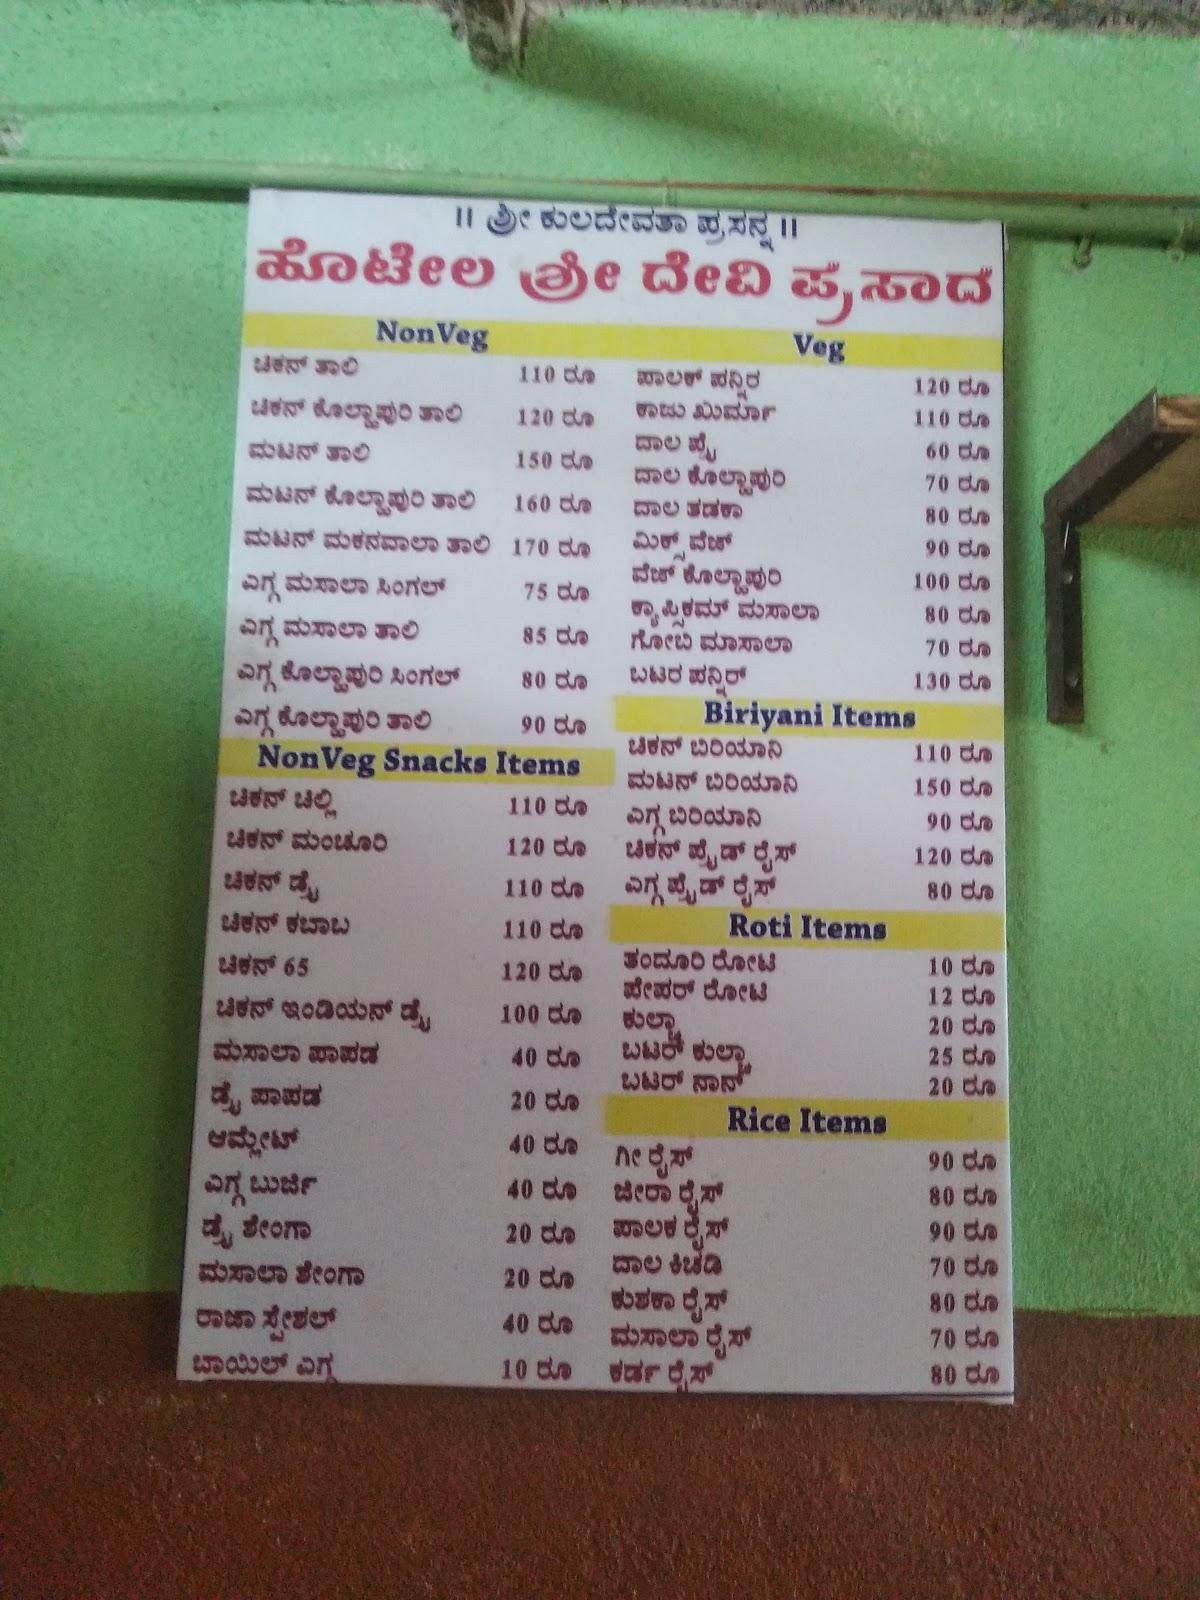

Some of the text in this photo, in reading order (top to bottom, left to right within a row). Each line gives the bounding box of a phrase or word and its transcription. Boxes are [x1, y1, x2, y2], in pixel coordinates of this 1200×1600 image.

[540, 203, 688, 234] ಕುಲದೇವತಾ
[697, 208, 775, 252] ಪ್ರಸನ್ನ
[641, 247, 773, 298] ದೇವಿ
[790, 261, 993, 326] ಪ್ರಸಾದ
[377, 320, 488, 353] NonVeg
[793, 333, 845, 364] Veg
[254, 355, 595, 384] ಚಿಕನ್ ತಾಲಿ 110 ರೂ
[916, 409, 950, 428] 110
[959, 409, 990, 429] ರೂ
[249, 440, 593, 471] ಮಟನ್ ತಾಲಿ 150 ರೂ
[246, 483, 317, 504] ಮಟನ್
[432, 490, 475, 510] ತಾಲಿ
[515, 495, 550, 513] 160
[560, 493, 591, 514] ರೂ
[634, 500, 679, 517] ದಾಲ
[926, 506, 949, 526] 80
[958, 505, 990, 526] ರೂ
[244, 528, 315, 548] ಮಟನ್
[447, 534, 491, 555] ತಾಲಿ
[514, 538, 549, 557] 170
[559, 537, 590, 558] ರೂ
[285, 572, 369, 594] ಮಸಾಲಾ
[377, 576, 446, 597] ಸಿಂಗಲ್
[525, 582, 547, 601] 75
[557, 581, 589, 602] ರೂ
[738, 599, 819, 621] ಮಸಾಲಾ
[926, 605, 949, 624] 80
[958, 604, 990, 625] ರೂ
[283, 617, 368, 639] ಮಸಾಲಾ
[375, 620, 419, 640] ತಾಲಿ
[523, 626, 546, 645] 85
[556, 625, 589, 646] ರೂ
[926, 639, 949, 657] 70
[959, 637, 991, 658] ರೂ
[705, 700, 915, 733] Biriyani Items
[258, 744, 580, 779] NonVeg Snacks Items
[628, 735, 992, 764] ಚಿಕನ್ ಬಿರಿಯಾನಿ 110 ರೂ
[628, 769, 992, 798] ಮಟನ್ ಬಿರಿಯಾನಿ 150 ರೂ
[230, 786, 288, 809] ಚಿಕನ್
[509, 796, 546, 816] 110
[555, 795, 588, 817] ರೂ
[669, 805, 761, 828] ಬಿರಿಯಾನಿ
[928, 812, 951, 832] 90
[960, 810, 993, 832] ರೂ
[227, 828, 285, 850] ಚಿಕನ್
[507, 837, 545, 857] 120
[553, 835, 587, 858] ರೂ
[224, 869, 282, 893] ಚಿಕನ್
[505, 878, 542, 898] 110
[551, 876, 584, 899] ರೂ
[221, 912, 584, 941] ಚಿಕನ್ ಕಬಾಬ 110 ರೂ
[730, 912, 886, 941] Roti Items
[218, 953, 583, 983] ಚಿಕನ್ 65 120 ರೂ
[624, 948, 995, 977] ತಂದೂರಿ ರೋಟಿ 10 ರೂ
[704, 977, 767, 1003] ರೋಟಿ
[929, 986, 952, 1007] 12
[962, 984, 995, 1007] ರೂ
[216, 996, 275, 1021] ಚಿಕನ್
[501, 1003, 539, 1026] 100
[548, 1002, 582, 1026] ರೂ
[213, 1038, 582, 1068] ಮಸಾಲಾ ಪಾಪಡ 40 ರೂ
[250, 1083, 322, 1108] ಪಾಪಡ
[511, 1089, 536, 1112] 20
[544, 1088, 580, 1112] ರೂ
[621, 1070, 996, 1097] ಬಟರ್ ನಾನ್ 20 ರೂ
[728, 1105, 886, 1136] Rice Items
[509, 1133, 536, 1155] 40
[544, 1131, 578, 1156] ರೂ
[615, 1142, 997, 1181] ಗೀ ರೈಸ್ 90 ರೂ
[679, 1179, 724, 1216] ರೈಸ್
[929, 1185, 955, 1208] 80
[963, 1183, 997, 1207] ರೂ
[242, 1213, 312, 1240] ಶೇಂಗಾ
[506, 1222, 531, 1246] 20
[540, 1221, 576, 1245] ರೂ
[613, 1214, 998, 1252] ಪಾಲಕ ರೈಸ್ 90 ರೂ
[198, 1259, 576, 1290] ಮಸಾಲಾ ಶೇಂಗಾ 20 ರೂ
[683, 1286, 728, 1326] ರೈಸ್
[930, 1291, 955, 1314] 80
[964, 1288, 1000, 1314] ರೂ
[610, 1322, 999, 1361] ಮಸಾಲಾ ರೈಸ್ 70 ರೂ
